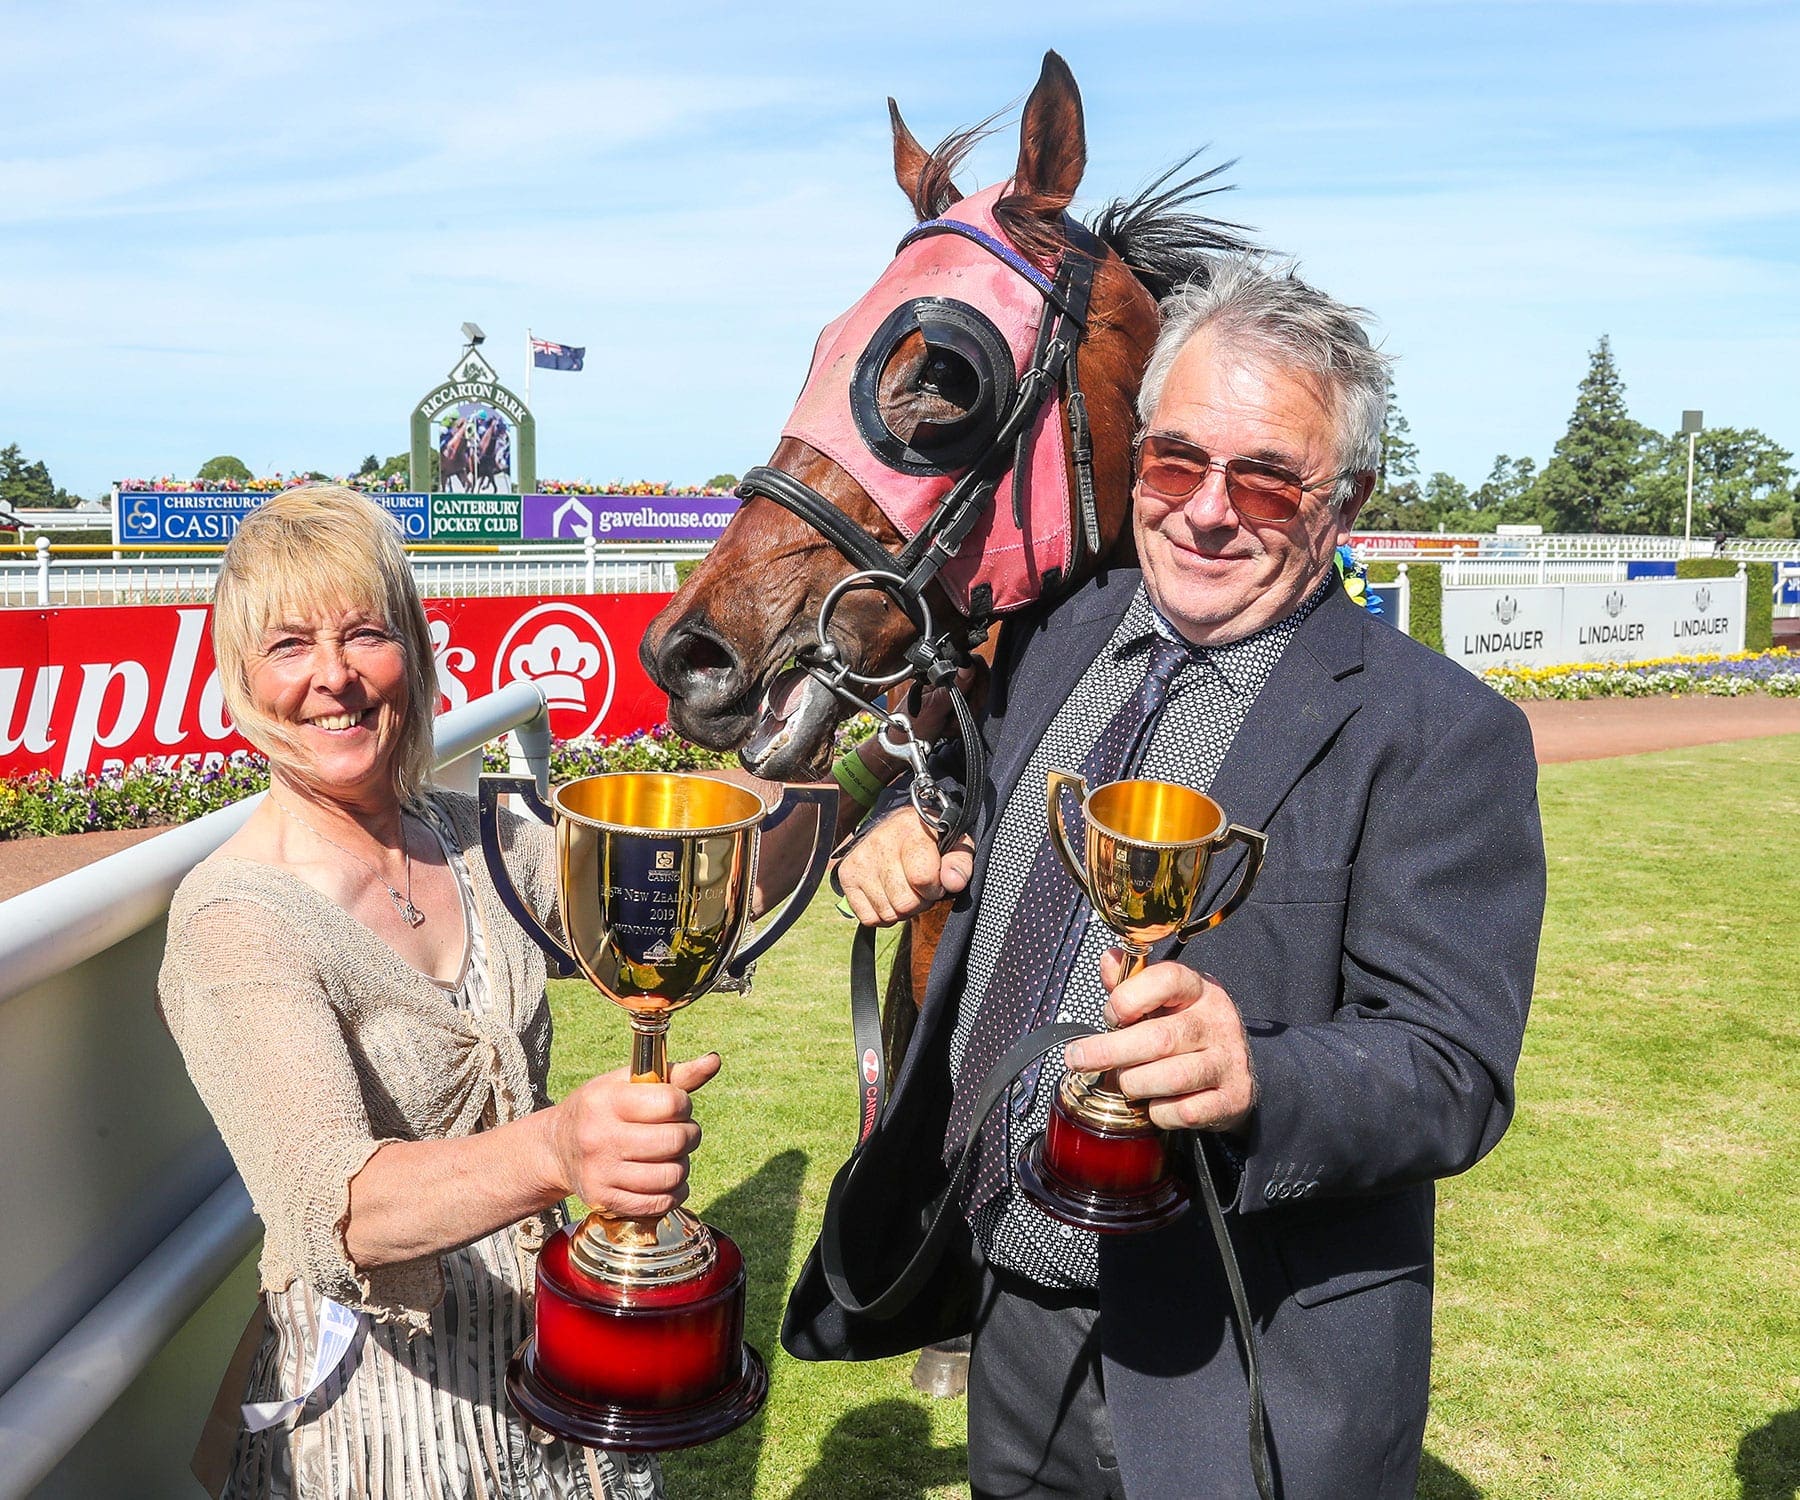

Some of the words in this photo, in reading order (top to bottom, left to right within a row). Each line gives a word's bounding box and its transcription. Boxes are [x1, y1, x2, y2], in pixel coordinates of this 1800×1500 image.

[421, 383, 493, 418] RICCARTON
[496, 388, 527, 423] PARK
[433, 500, 519, 515] CANTERBURY
[432, 517, 481, 535] JOCKEY
[484, 517, 518, 533] CLUB
[1579, 624, 1645, 645] LINDAUER
[1674, 617, 1729, 637] LINDAUER
[1464, 631, 1544, 655] LINDAUER
[647, 874, 681, 882] CASINO
[650, 908, 675, 921] 2019
[613, 923, 666, 936] WINNING
